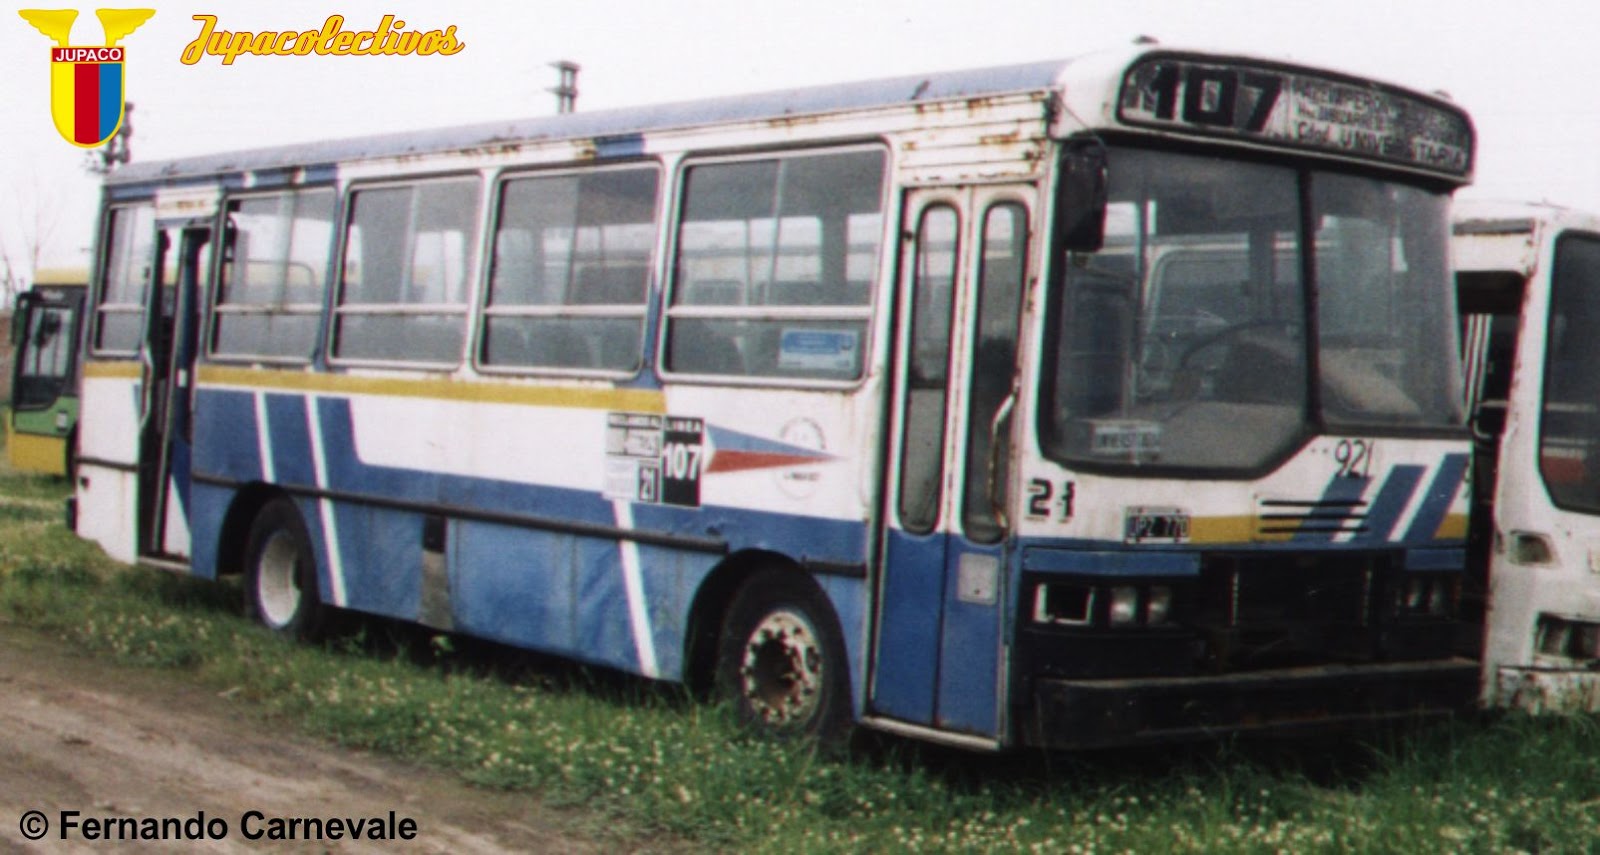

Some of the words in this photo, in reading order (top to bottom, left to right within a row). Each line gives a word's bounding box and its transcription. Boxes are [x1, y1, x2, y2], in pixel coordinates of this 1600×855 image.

[1147, 64, 1282, 132] 107
[663, 442, 701, 480] 107
[1027, 478, 1074, 523] 21
